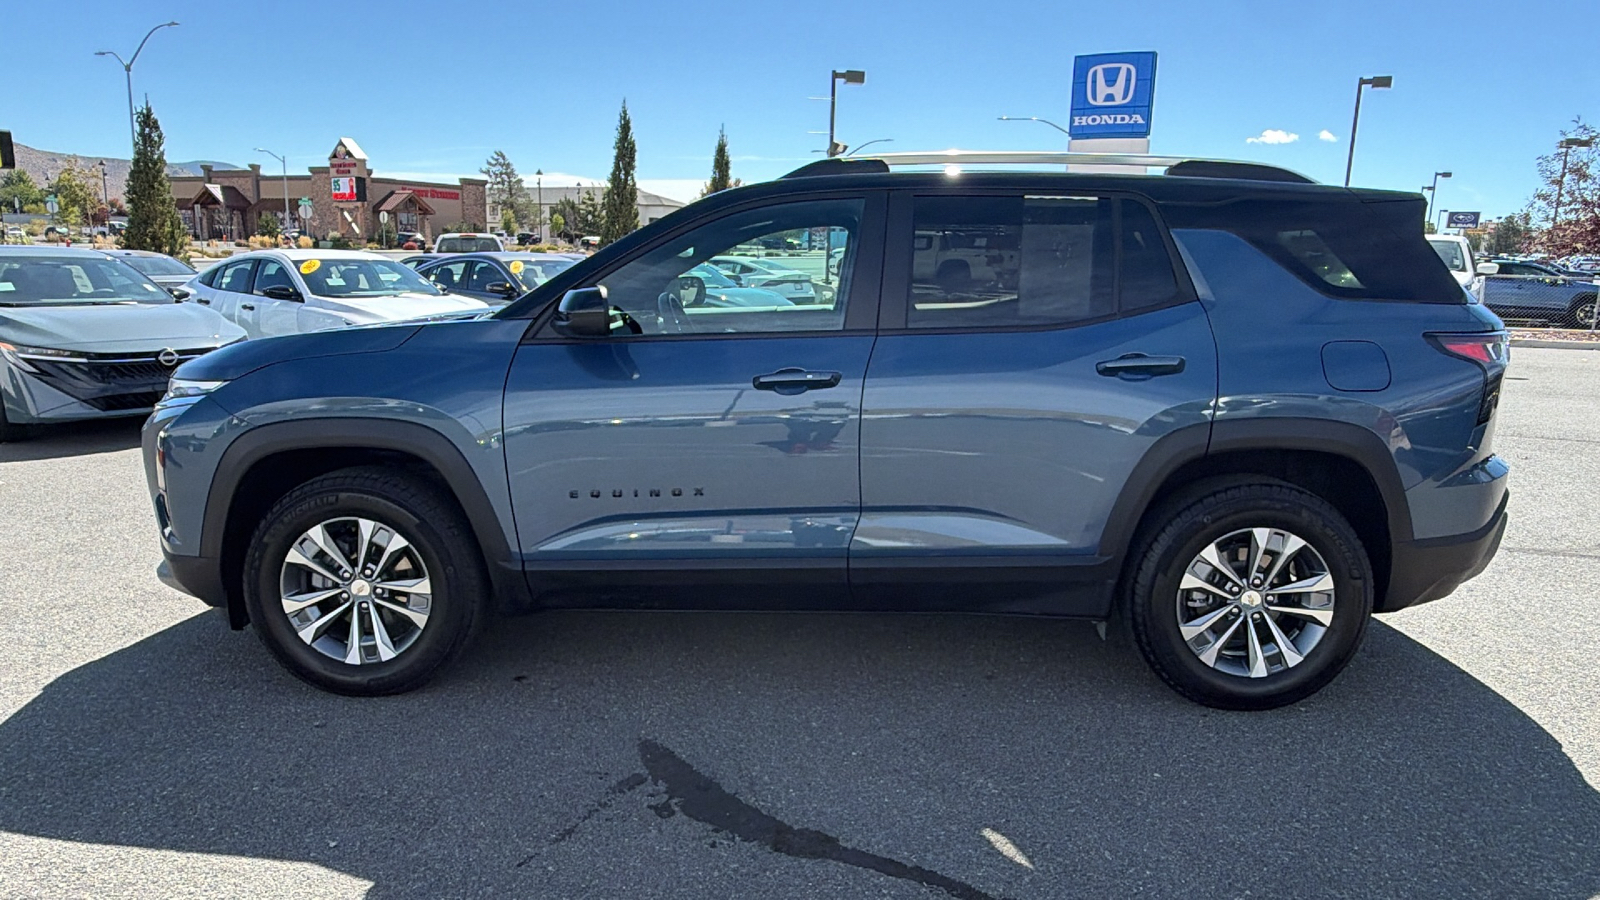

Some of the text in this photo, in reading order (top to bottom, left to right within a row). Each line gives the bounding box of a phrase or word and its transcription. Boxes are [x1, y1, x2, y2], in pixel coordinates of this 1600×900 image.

[1073, 114, 1145, 125] HONDA
[568, 487, 705, 499] EQUINOX
[281, 494, 338, 522] MICHELIN
